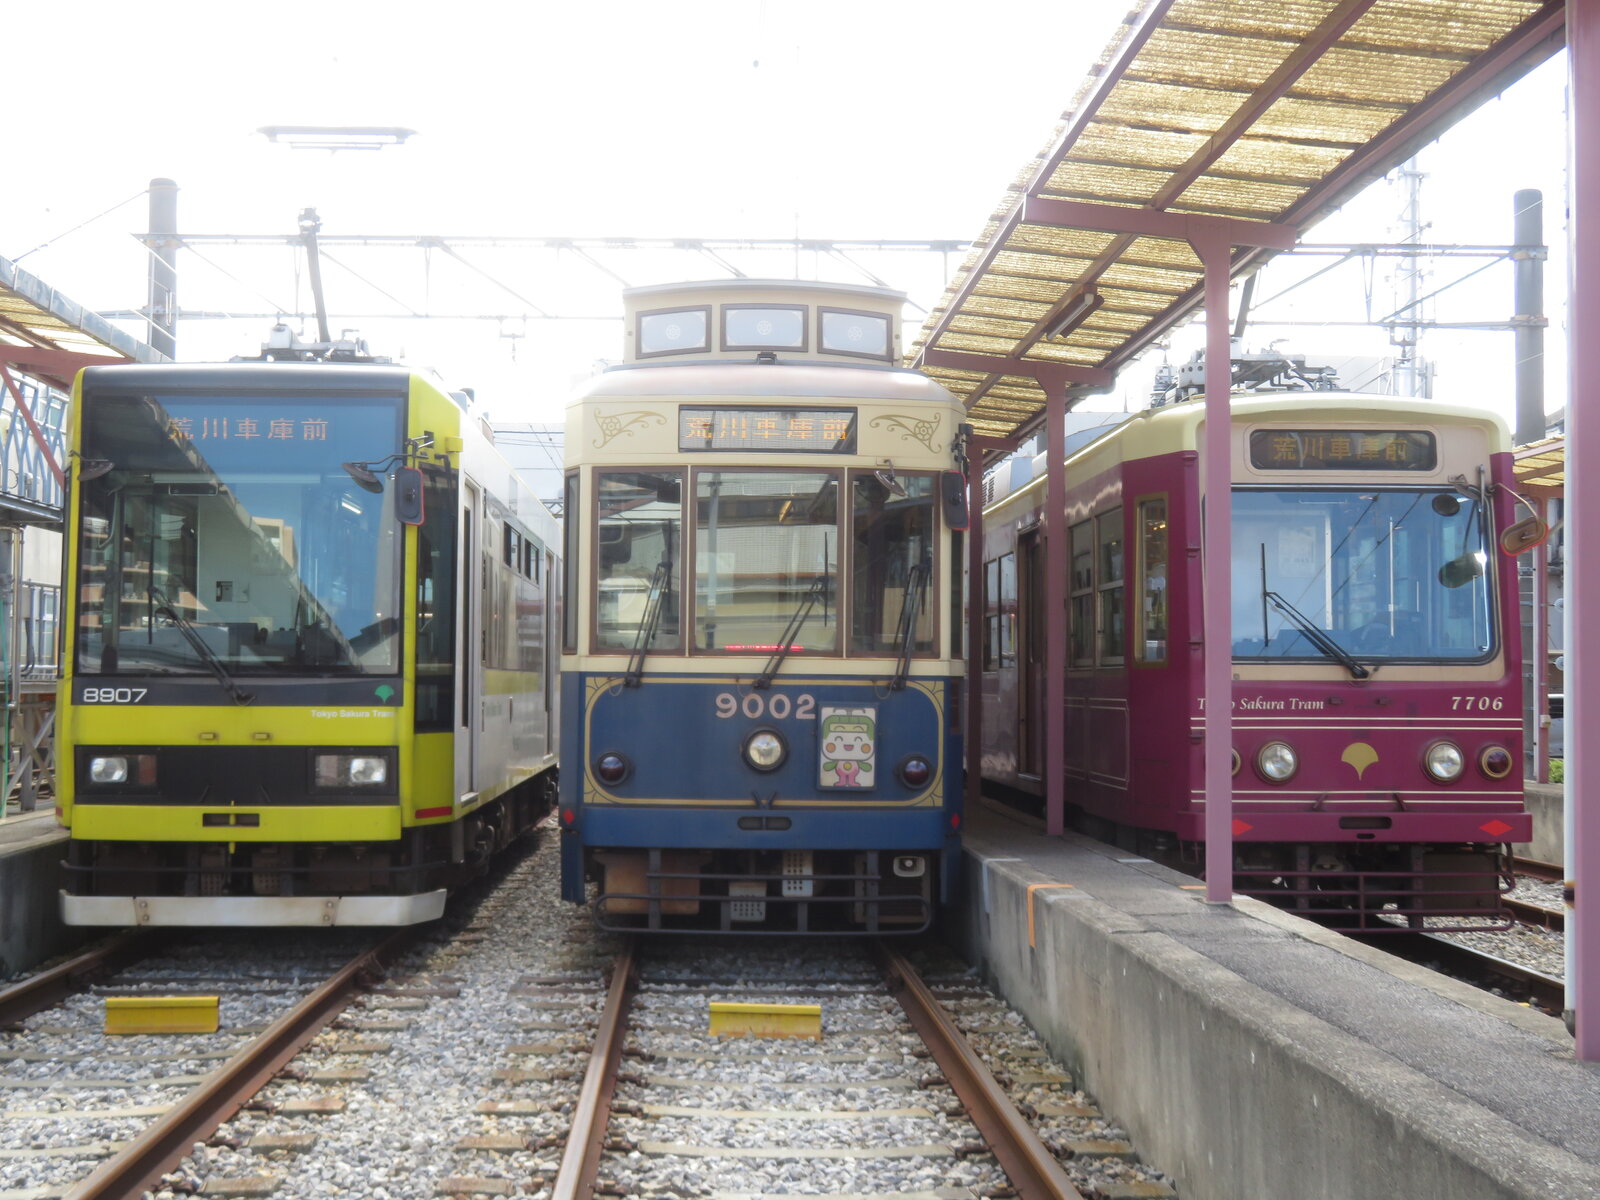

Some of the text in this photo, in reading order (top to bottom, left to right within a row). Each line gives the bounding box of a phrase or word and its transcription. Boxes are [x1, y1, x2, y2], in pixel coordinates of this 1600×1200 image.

[168, 417, 329, 441] 荒川車庫前
[682, 416, 847, 440] 荒川車庫前
[1273, 437, 1408, 461] 荒川車庫前
[83, 688, 148, 703] 8907
[1239, 696, 1285, 710] Sakura
[1289, 697, 1324, 710] Tram
[1452, 696, 1503, 711] 7706
[310, 709, 338, 719] Tokyo
[339, 709, 370, 718] Sakura
[715, 692, 816, 720] 9002
